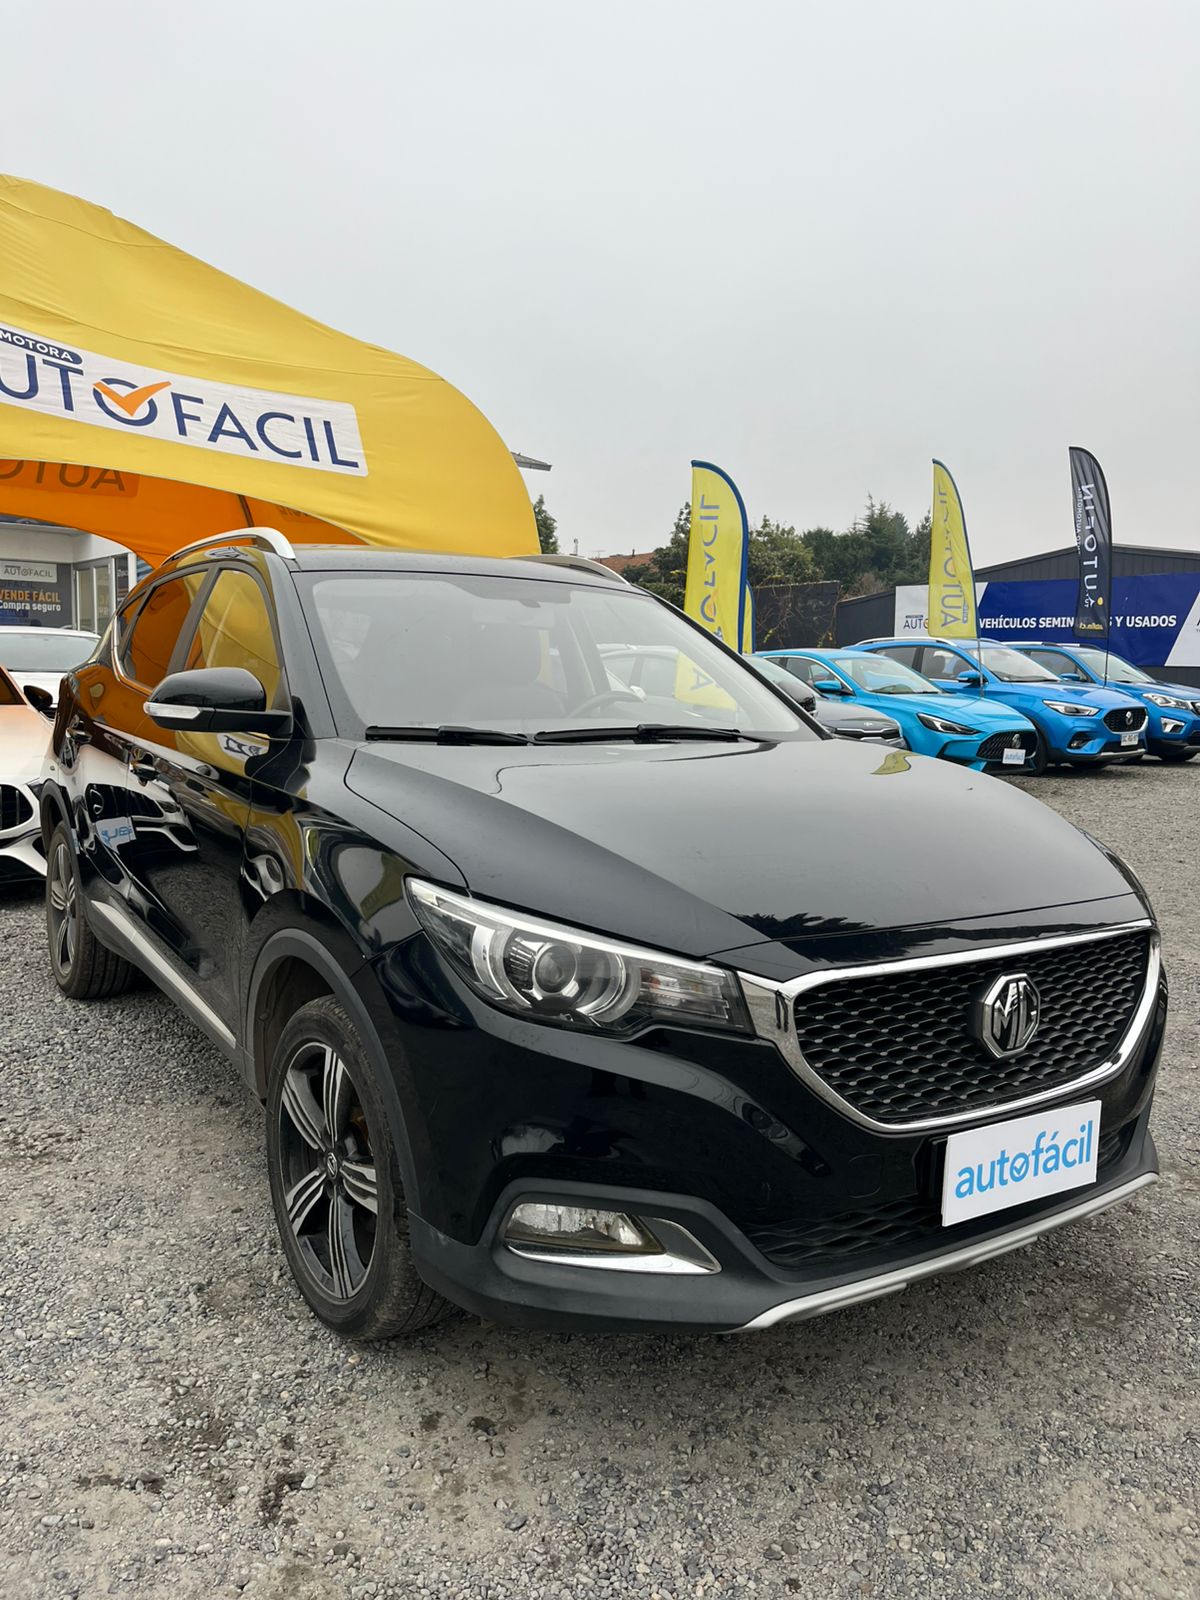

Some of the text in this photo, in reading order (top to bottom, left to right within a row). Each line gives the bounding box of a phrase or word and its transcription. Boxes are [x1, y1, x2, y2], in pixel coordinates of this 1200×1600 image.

[0, 589, 30, 601] VENDE
[32, 603, 61, 612] seguro
[979, 614, 1037, 629] VEHÍCULOS
[1115, 616, 1123, 627] Y
[1126, 615, 1176, 628] USADOS
[954, 1119, 1094, 1199] autofácil
